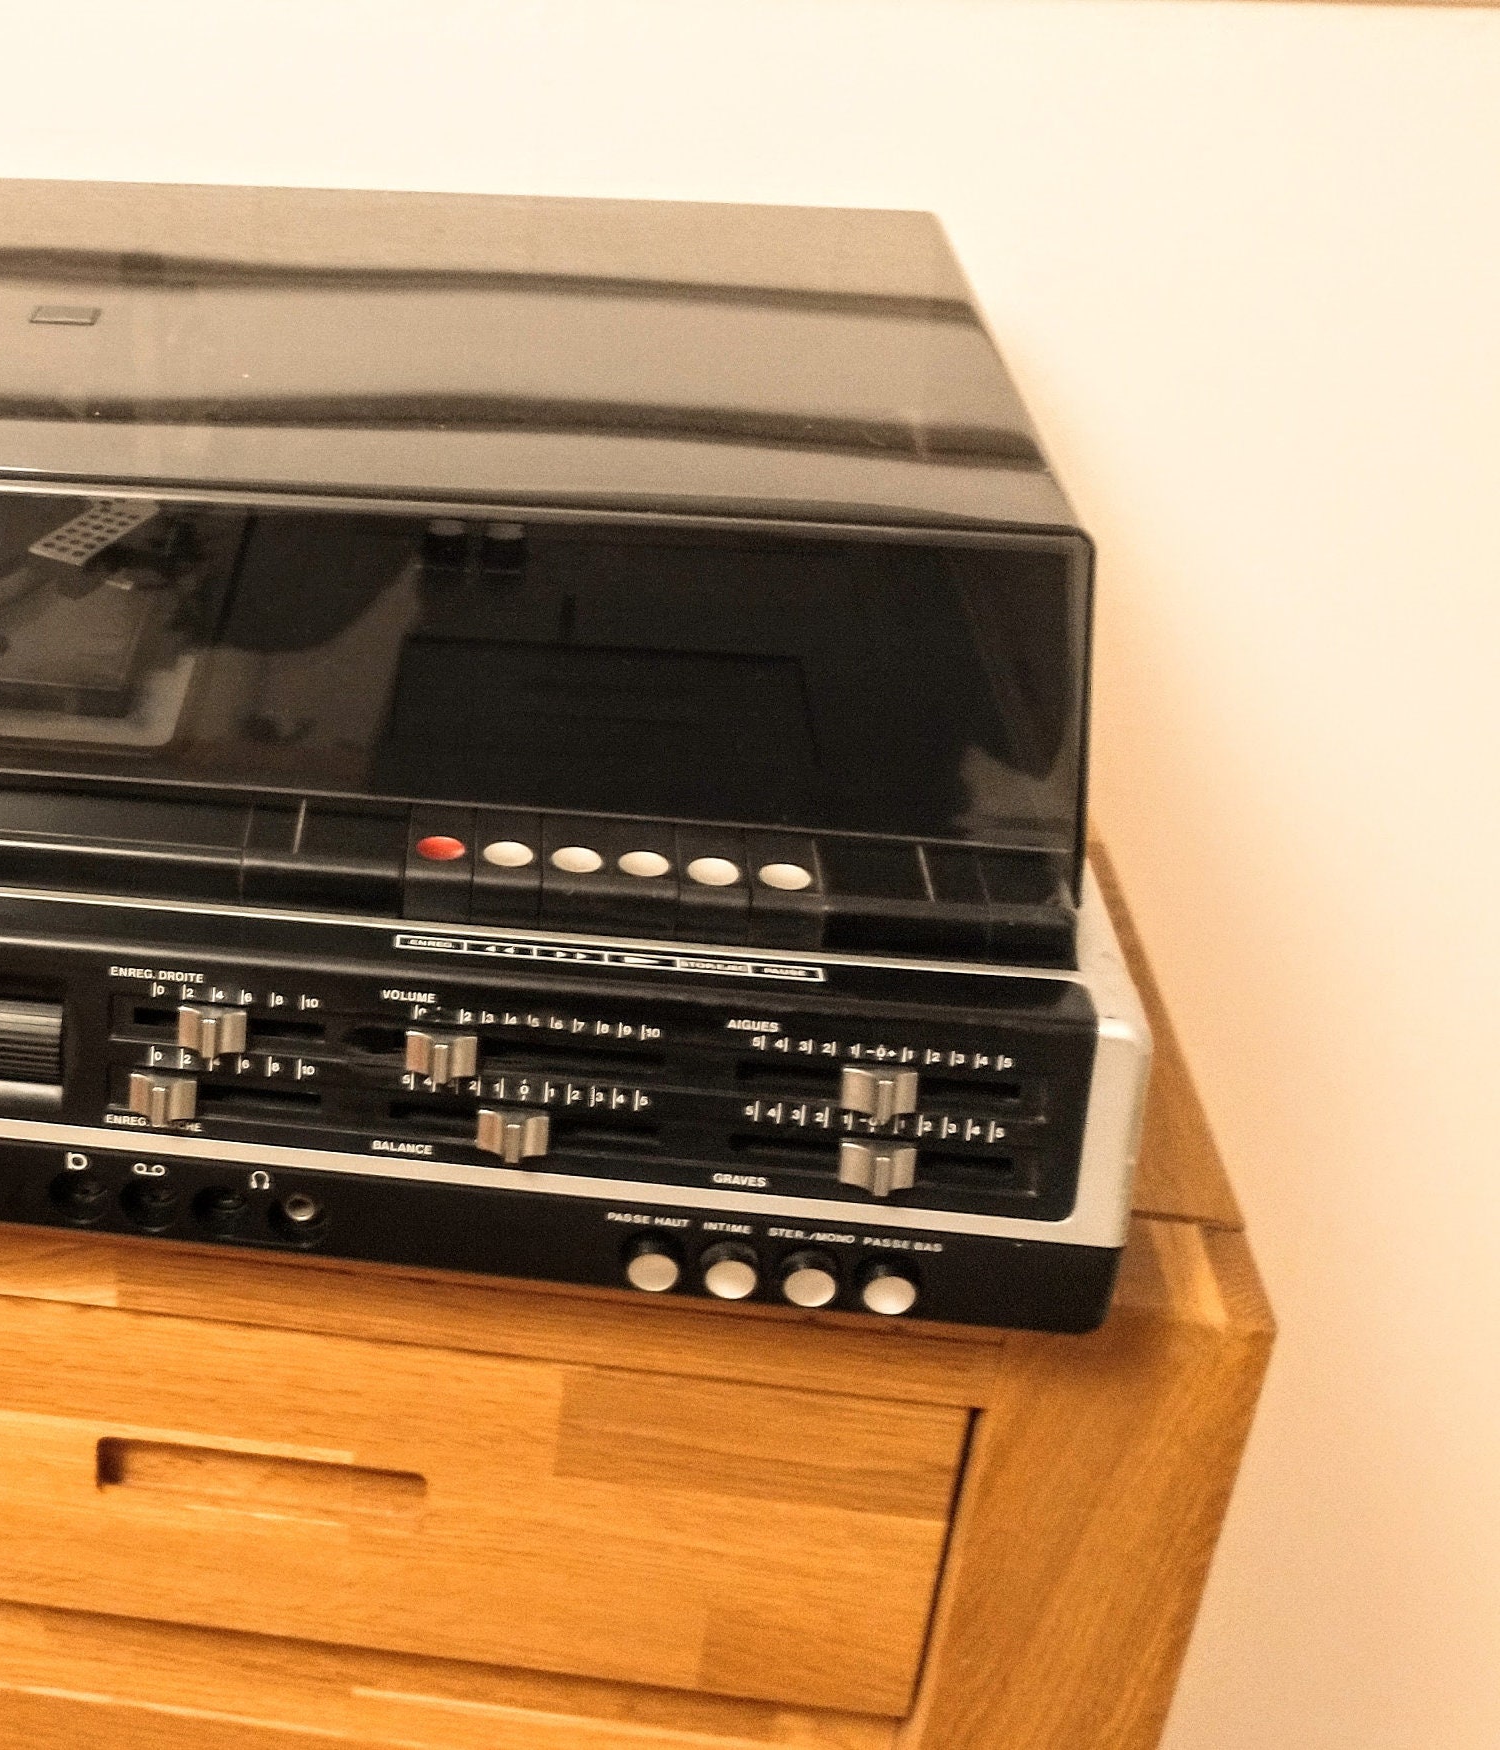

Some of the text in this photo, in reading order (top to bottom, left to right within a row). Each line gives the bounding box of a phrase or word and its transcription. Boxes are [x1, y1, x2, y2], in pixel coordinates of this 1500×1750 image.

[110, 966, 204, 984] ENREG. DROITE
[763, 968, 807, 977] PAUSE
[186, 988, 194, 997] 2
[215, 990, 224, 1000] 4
[244, 992, 253, 1002] 6
[275, 996, 284, 1006] 8
[305, 998, 319, 1008] 10
[382, 989, 437, 1003] VOLUME
[463, 1011, 661, 1038] 2 3 4 5 6 7 8 9 10
[727, 1018, 779, 1033] AIGUES
[183, 1054, 192, 1065] 2
[241, 1059, 250, 1069] 6
[271, 1062, 280, 1073] 8
[302, 1065, 315, 1076] 10
[931, 1052, 941, 1063] 2
[956, 1053, 965, 1064] 3
[979, 1056, 988, 1066] 4
[1004, 1057, 1013, 1068] 5
[402, 1074, 411, 1084] 5
[469, 1081, 477, 1090] 2
[571, 1090, 580, 1100] 2
[595, 1092, 604, 1102] 3
[616, 1094, 625, 1104] 4
[639, 1096, 649, 1106] 5
[745, 1105, 753, 1116] 5
[767, 1108, 776, 1117] 4
[791, 1109, 800, 1120] 3
[815, 1112, 824, 1122] 2
[923, 1121, 932, 1131] 2
[948, 1123, 956, 1134] 3
[971, 1126, 980, 1135] 4
[996, 1127, 1005, 1138] 5
[373, 1140, 433, 1155] BALANCE
[713, 1173, 767, 1188] GRAVES
[607, 1212, 690, 1228] PASSE HAUT
[703, 1222, 752, 1235] INTIME
